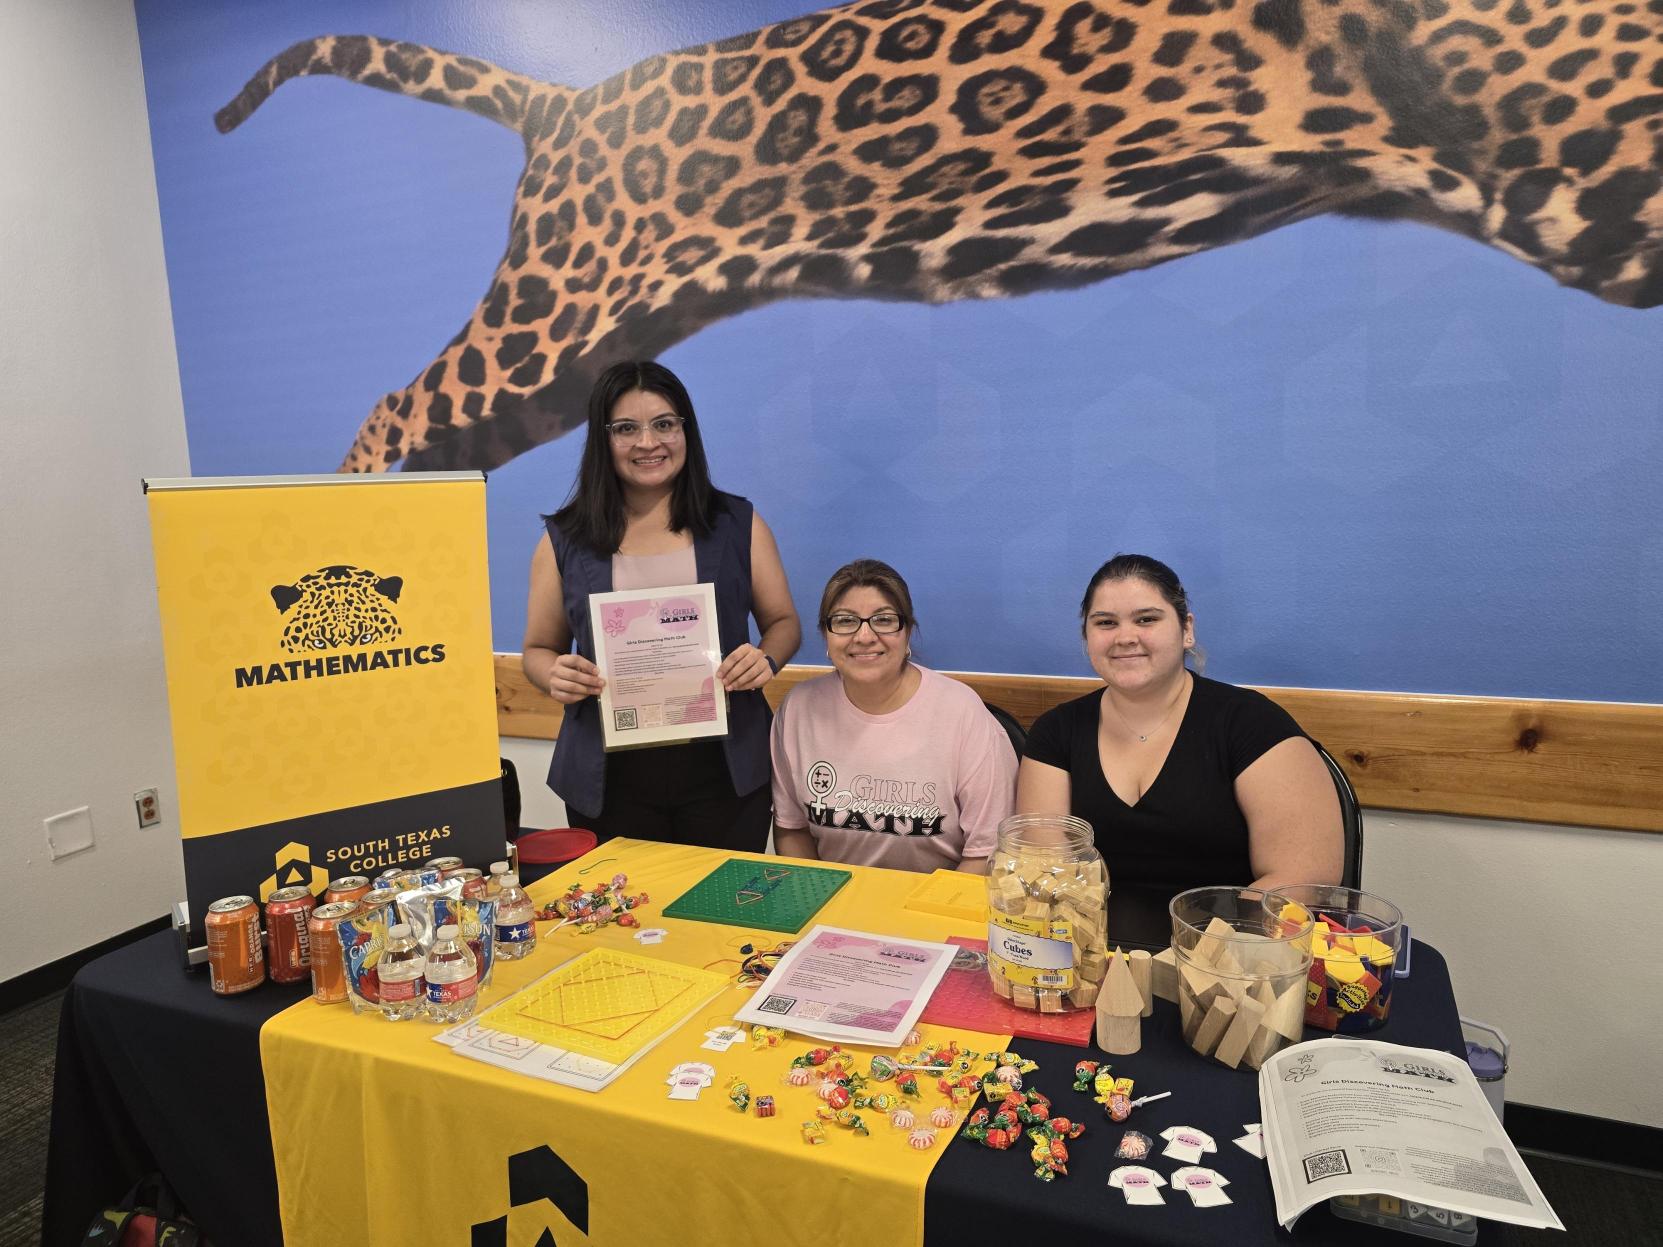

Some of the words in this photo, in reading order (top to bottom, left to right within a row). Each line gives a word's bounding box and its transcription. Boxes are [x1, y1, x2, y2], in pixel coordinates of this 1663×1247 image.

[660, 614, 699, 624] MATH
[234, 643, 446, 688] MATHEMATICS
[850, 775, 937, 806] GIRLS
[834, 790, 940, 826] Discovering
[326, 838, 389, 862] SOUTH
[396, 825, 451, 847] TEXAS
[350, 845, 432, 873] COLLEGE
[285, 906, 311, 967] Original
[1003, 940, 1033, 956] Cubes
[1382, 1066, 1457, 1084] MATH
[1403, 1063, 1446, 1075] GIRLS
[1341, 1079, 1390, 1089] Discovering
[1391, 1083, 1413, 1091] Math
